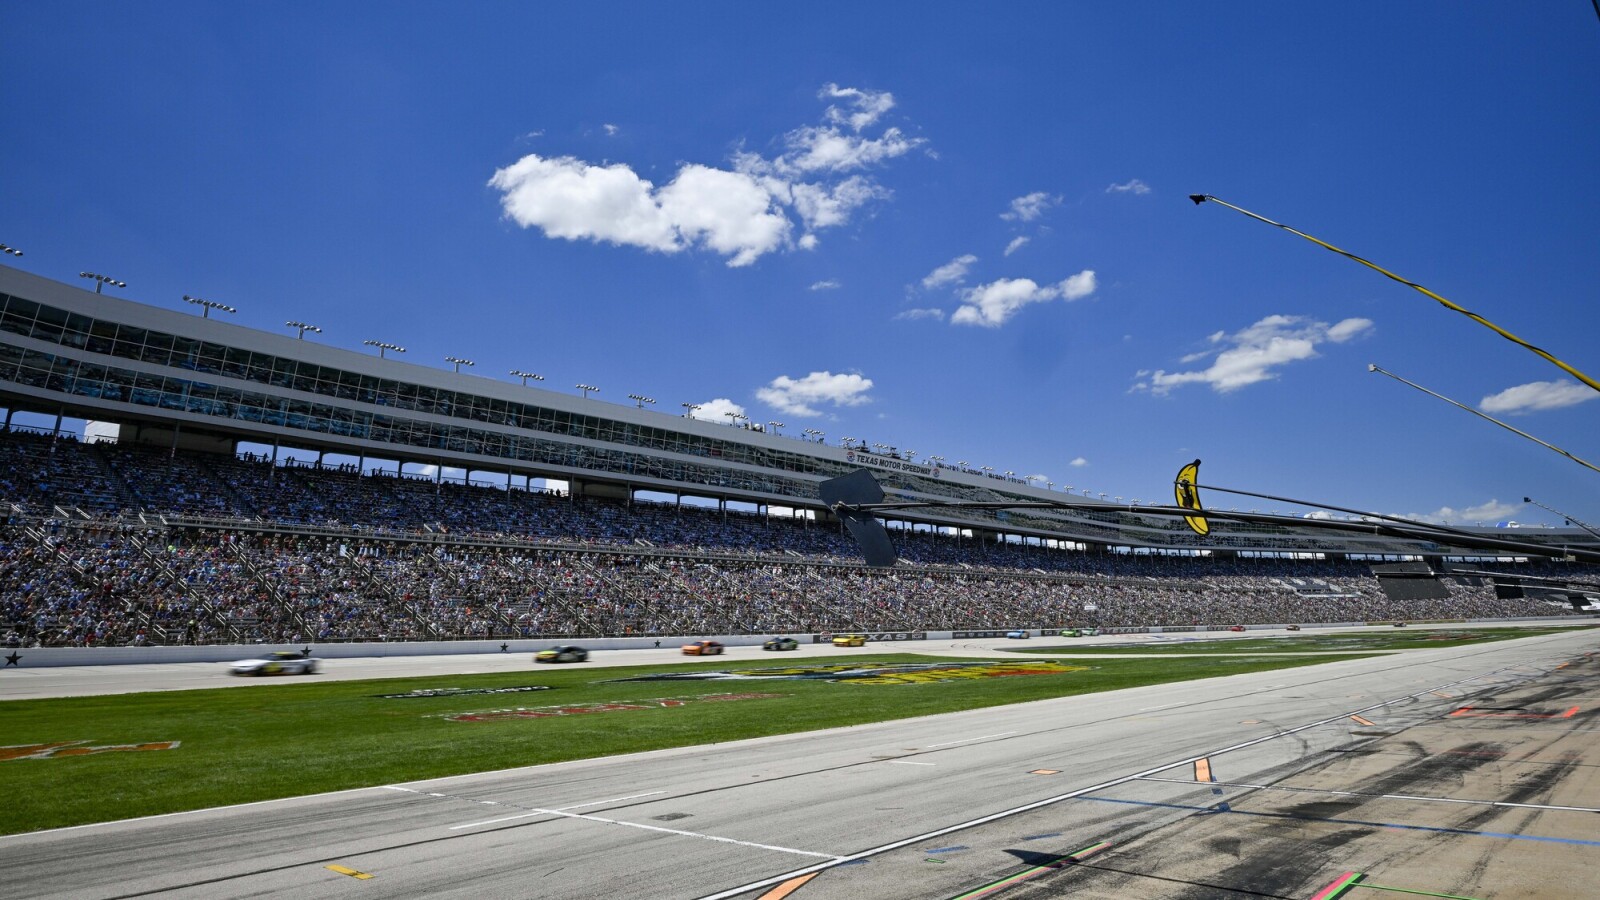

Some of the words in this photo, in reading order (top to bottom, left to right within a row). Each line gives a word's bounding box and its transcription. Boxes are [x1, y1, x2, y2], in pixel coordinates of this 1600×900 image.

[857, 455, 878, 465] TEXAS
[879, 459, 901, 470] MOTOR
[901, 463, 931, 475] SPEEDWAY
